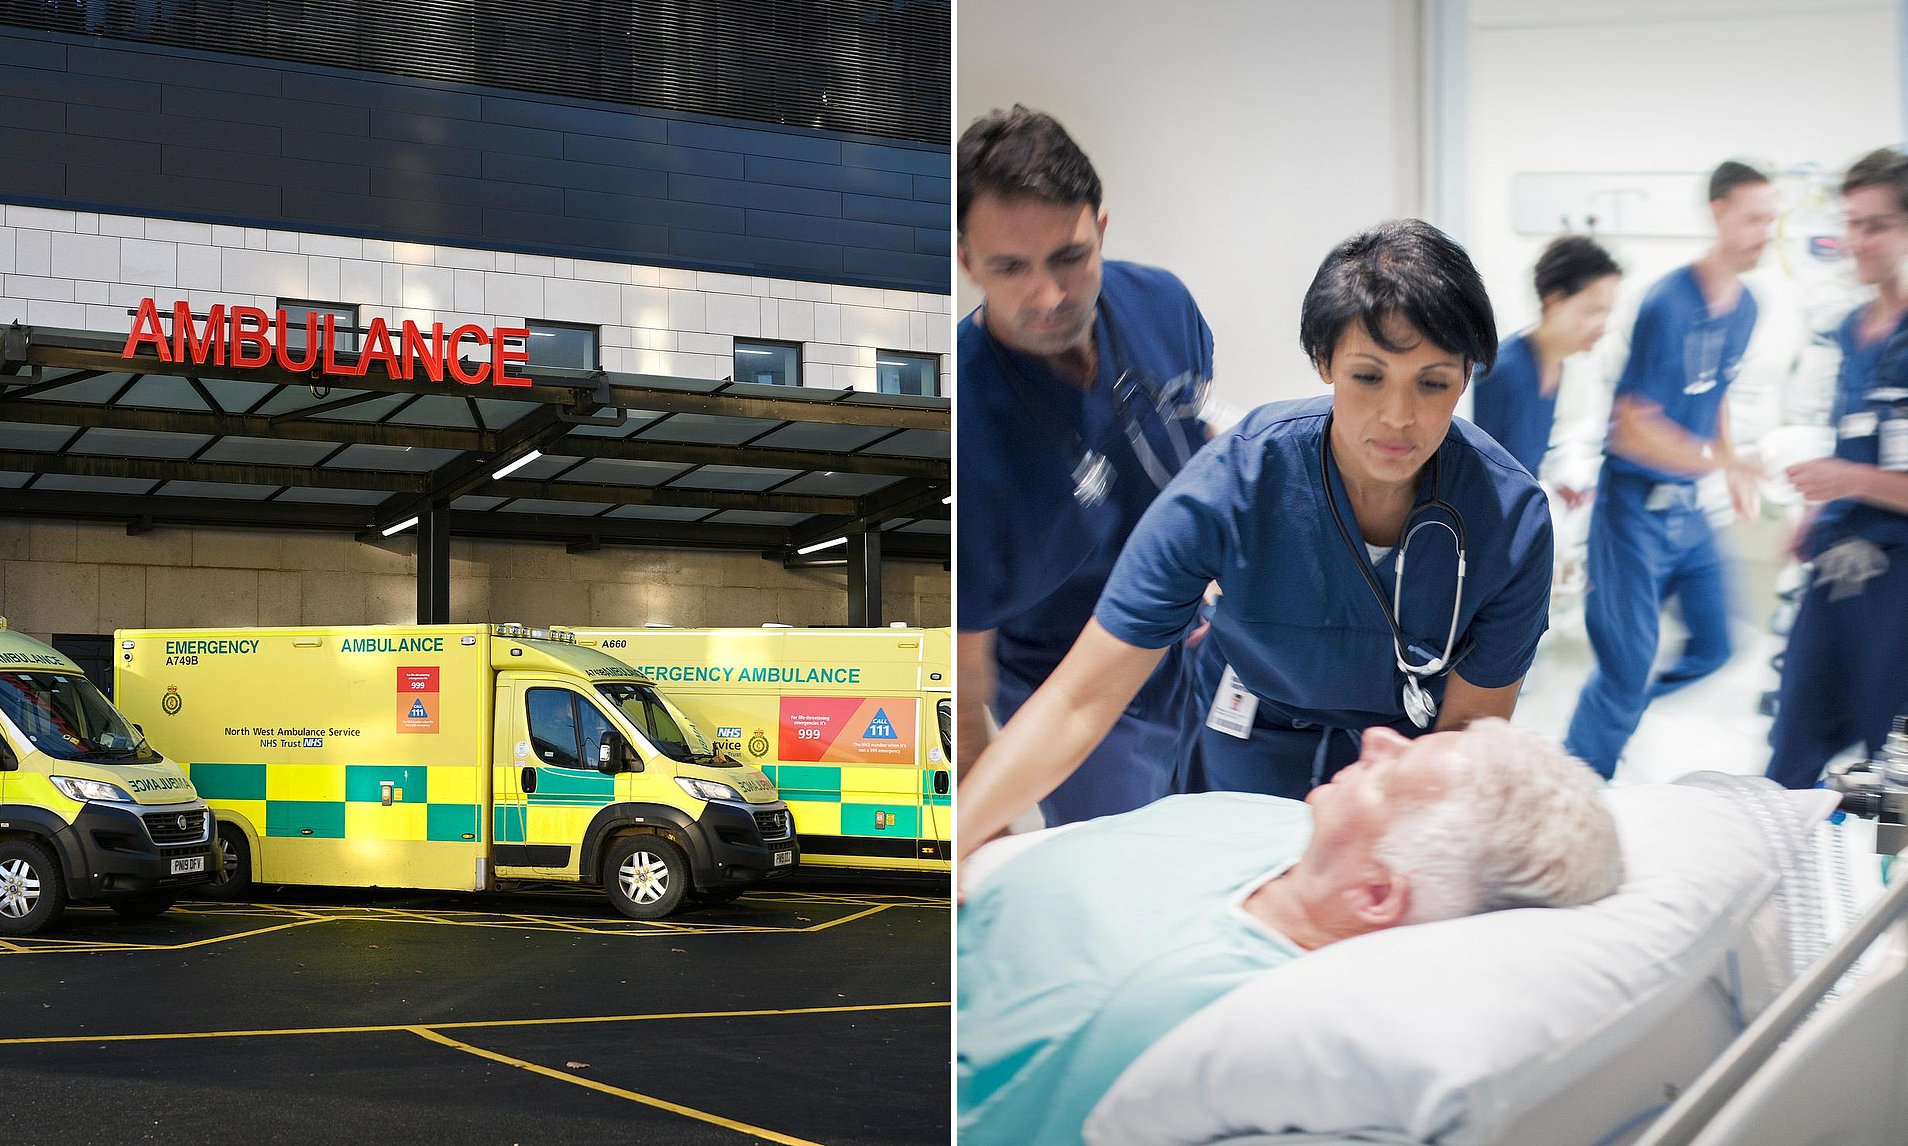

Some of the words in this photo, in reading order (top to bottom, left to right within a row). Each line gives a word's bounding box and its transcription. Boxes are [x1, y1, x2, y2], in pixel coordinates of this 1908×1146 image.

[121, 298, 532, 387] AMBULANCE
[165, 640, 260, 654] EMERGENCY
[341, 638, 444, 653] AMBULANCE
[602, 639, 627, 648] A660
[165, 656, 199, 666] A749B
[637, 666, 732, 681] ERGENCY
[738, 668, 861, 684] AMBULANCE
[225, 727, 251, 736] North
[254, 727, 275, 736] West
[277, 727, 325, 737] Ambulance
[328, 728, 361, 737] Service
[717, 728, 741, 737] NHS
[798, 729, 821, 740] 999
[869, 725, 890, 737] 111
[260, 739, 278, 748] NHS
[281, 739, 301, 748] Trust
[304, 738, 323, 748] NHS
[712, 739, 741, 750] rvice
